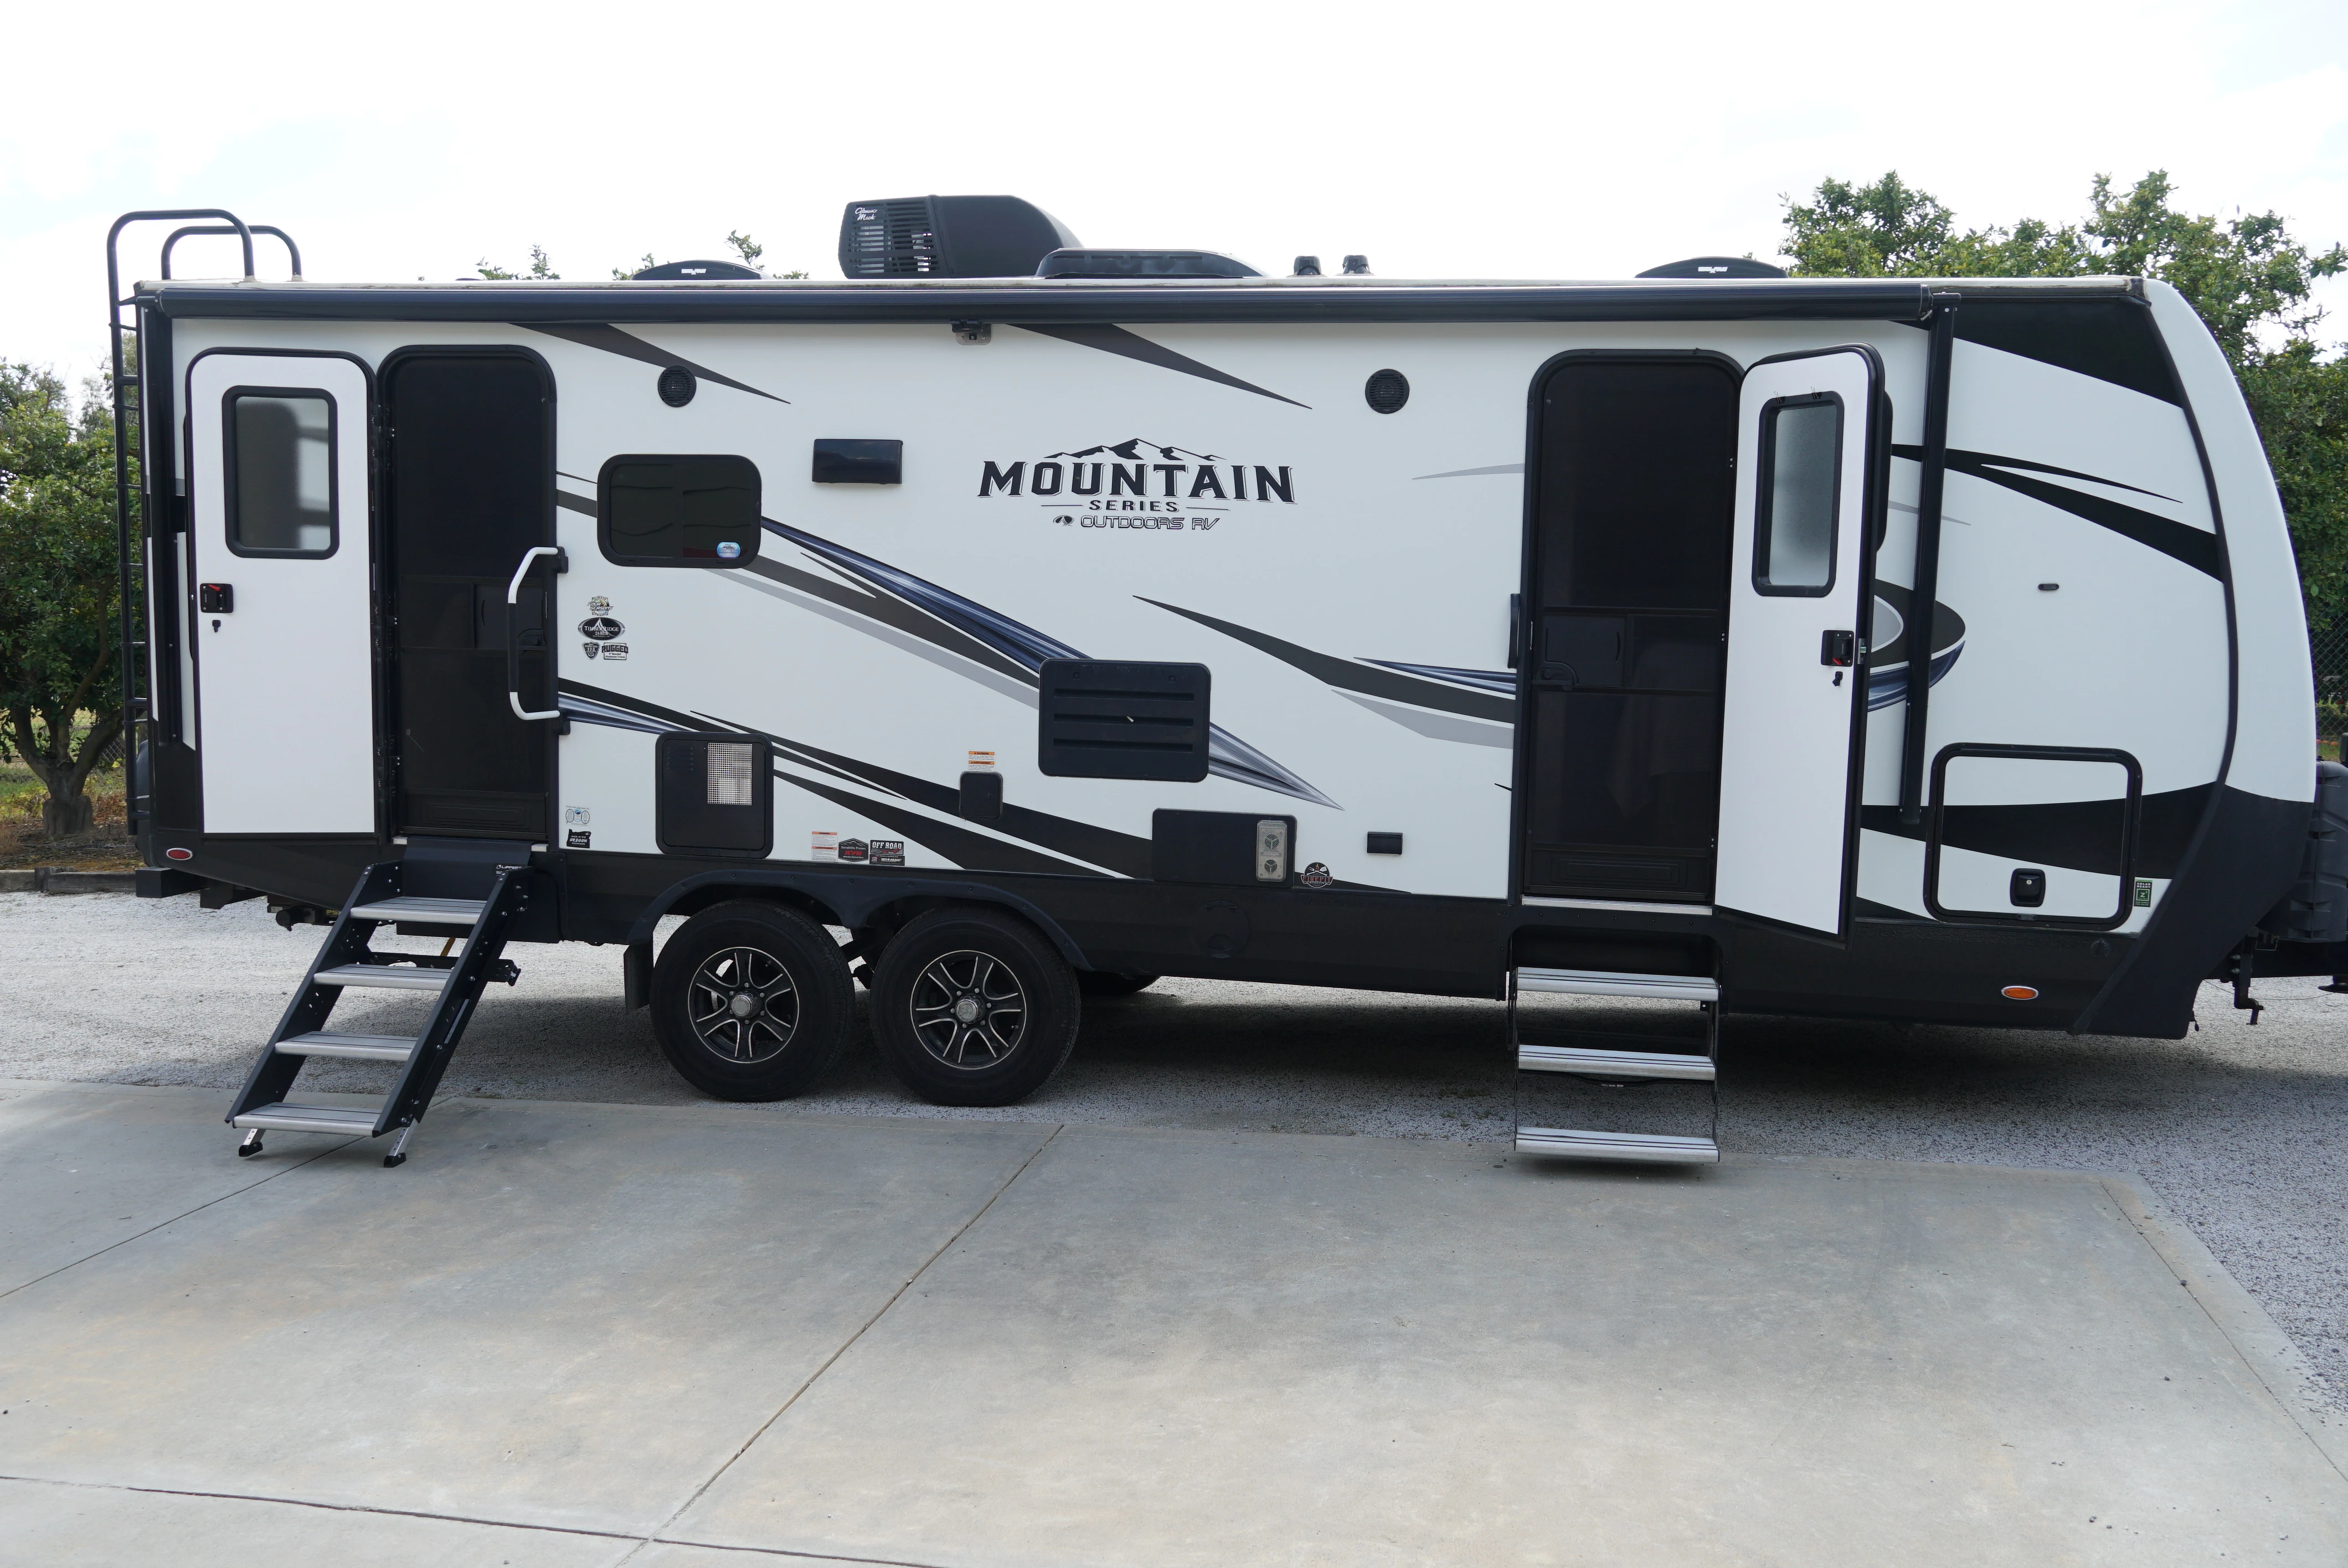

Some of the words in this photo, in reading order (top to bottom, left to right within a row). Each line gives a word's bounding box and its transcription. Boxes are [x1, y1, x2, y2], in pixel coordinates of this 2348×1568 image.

[977, 460, 1297, 504] MOUNTAIN
[1089, 500, 1180, 512] SERIES
[1080, 515, 1185, 530] OUTDOORS
[1192, 518, 1221, 530] RV
[601, 644, 629, 653] RUGGED
